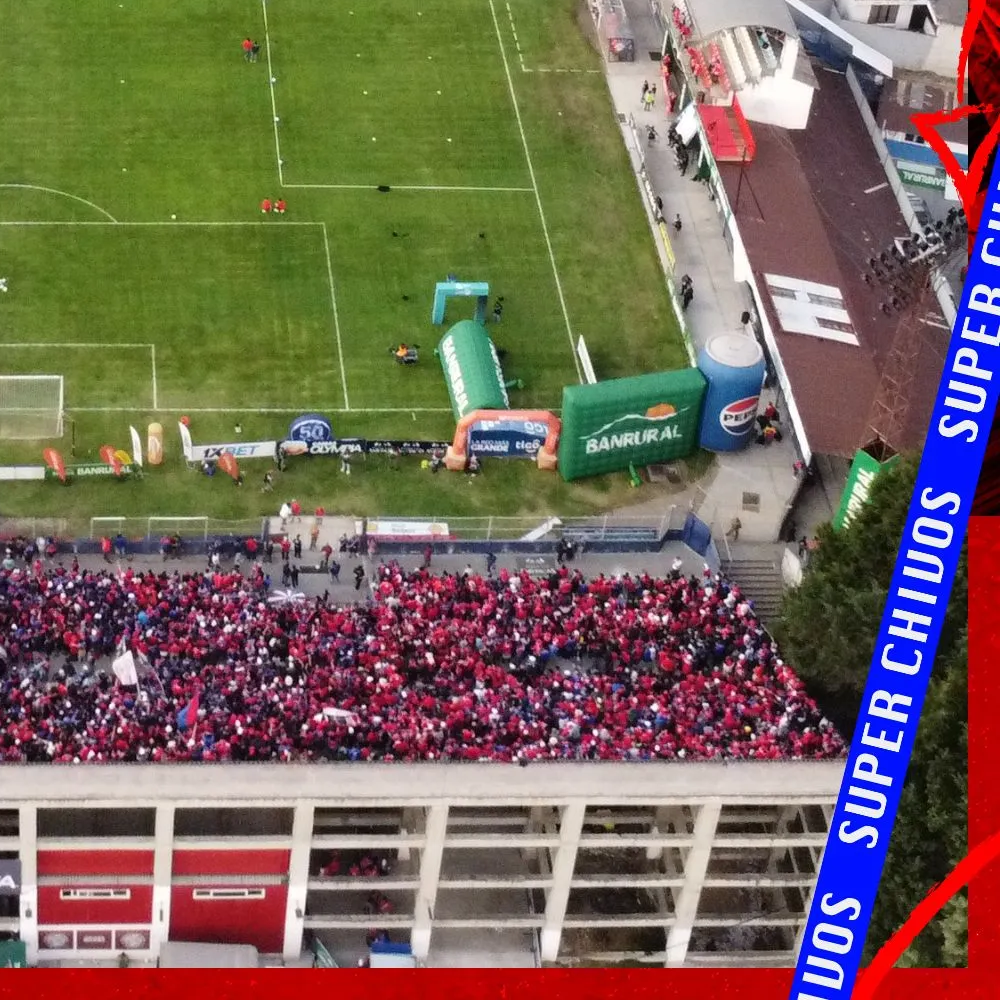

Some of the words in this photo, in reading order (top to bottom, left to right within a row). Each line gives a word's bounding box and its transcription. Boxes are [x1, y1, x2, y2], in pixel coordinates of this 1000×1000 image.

[300, 424, 324, 441] 50
[586, 424, 682, 454] BANRURAL
[204, 446, 260, 458] 1XBET
[310, 444, 362, 454] OLYMPIA
[471, 444, 509, 452] GRANDE
[515, 439, 541, 453] tigo
[77, 466, 132, 476] BANRUAL
